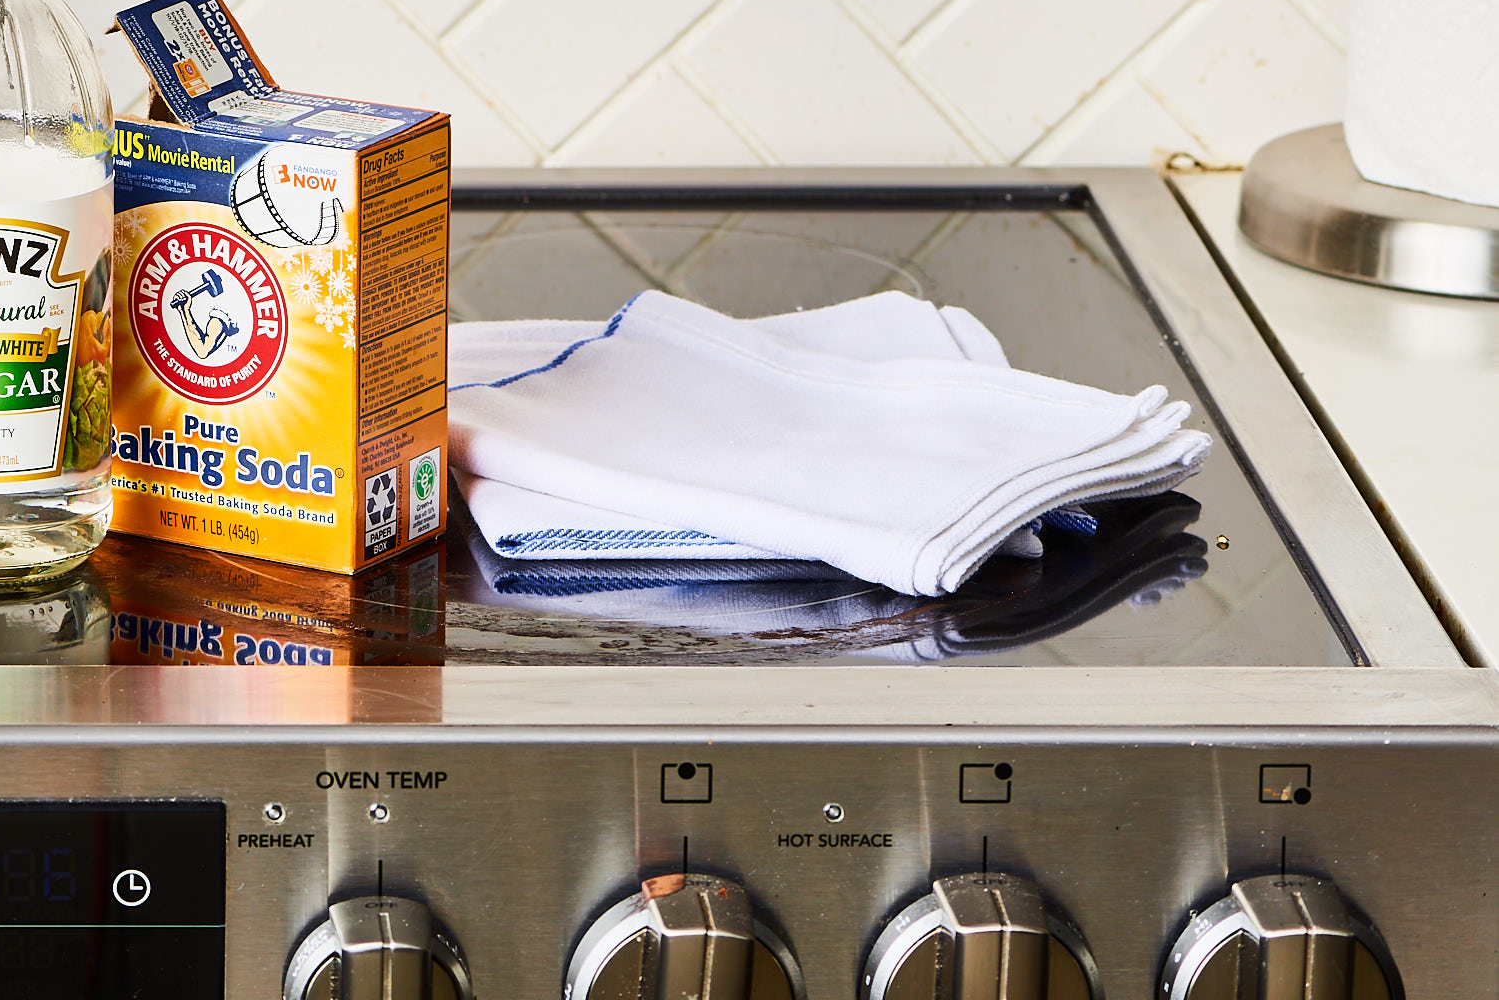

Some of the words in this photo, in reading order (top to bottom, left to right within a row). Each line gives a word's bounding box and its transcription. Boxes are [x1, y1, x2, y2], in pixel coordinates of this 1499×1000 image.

[194, 2, 234, 53] Movie
[148, 144, 189, 168] Movie
[191, 151, 235, 174] Rental
[293, 165, 337, 177] FANDANGO
[364, 158, 382, 174] Drug
[384, 149, 404, 167] Facts
[294, 174, 337, 192] NOW
[138, 252, 171, 321] ARM
[168, 239, 191, 264] &
[192, 234, 279, 339] HAMMER
[153, 338, 168, 361] THE
[168, 357, 218, 388] STANDARD
[219, 376, 232, 388] OF
[232, 354, 262, 385] PURITY
[184, 414, 239, 443] Pure
[237, 449, 334, 495] Soda
[112, 476, 147, 493] erica's
[151, 484, 165, 496] #1
[170, 487, 213, 504] Trusted
[218, 496, 258, 515] Baking
[263, 503, 293, 518] Soda
[298, 509, 334, 524] Brand
[160, 510, 178, 528] NET
[180, 515, 199, 531] WT.
[210, 520, 226, 537] LB.
[228, 524, 260, 545] (454g)
[370, 526, 392, 543] PAPER
[373, 540, 388, 555] BOX
[315, 771, 380, 790] OVEN
[387, 771, 448, 789] TEMP
[237, 834, 314, 849] PREHEAT
[777, 834, 813, 848] HOT
[818, 834, 893, 848] SURFACE
